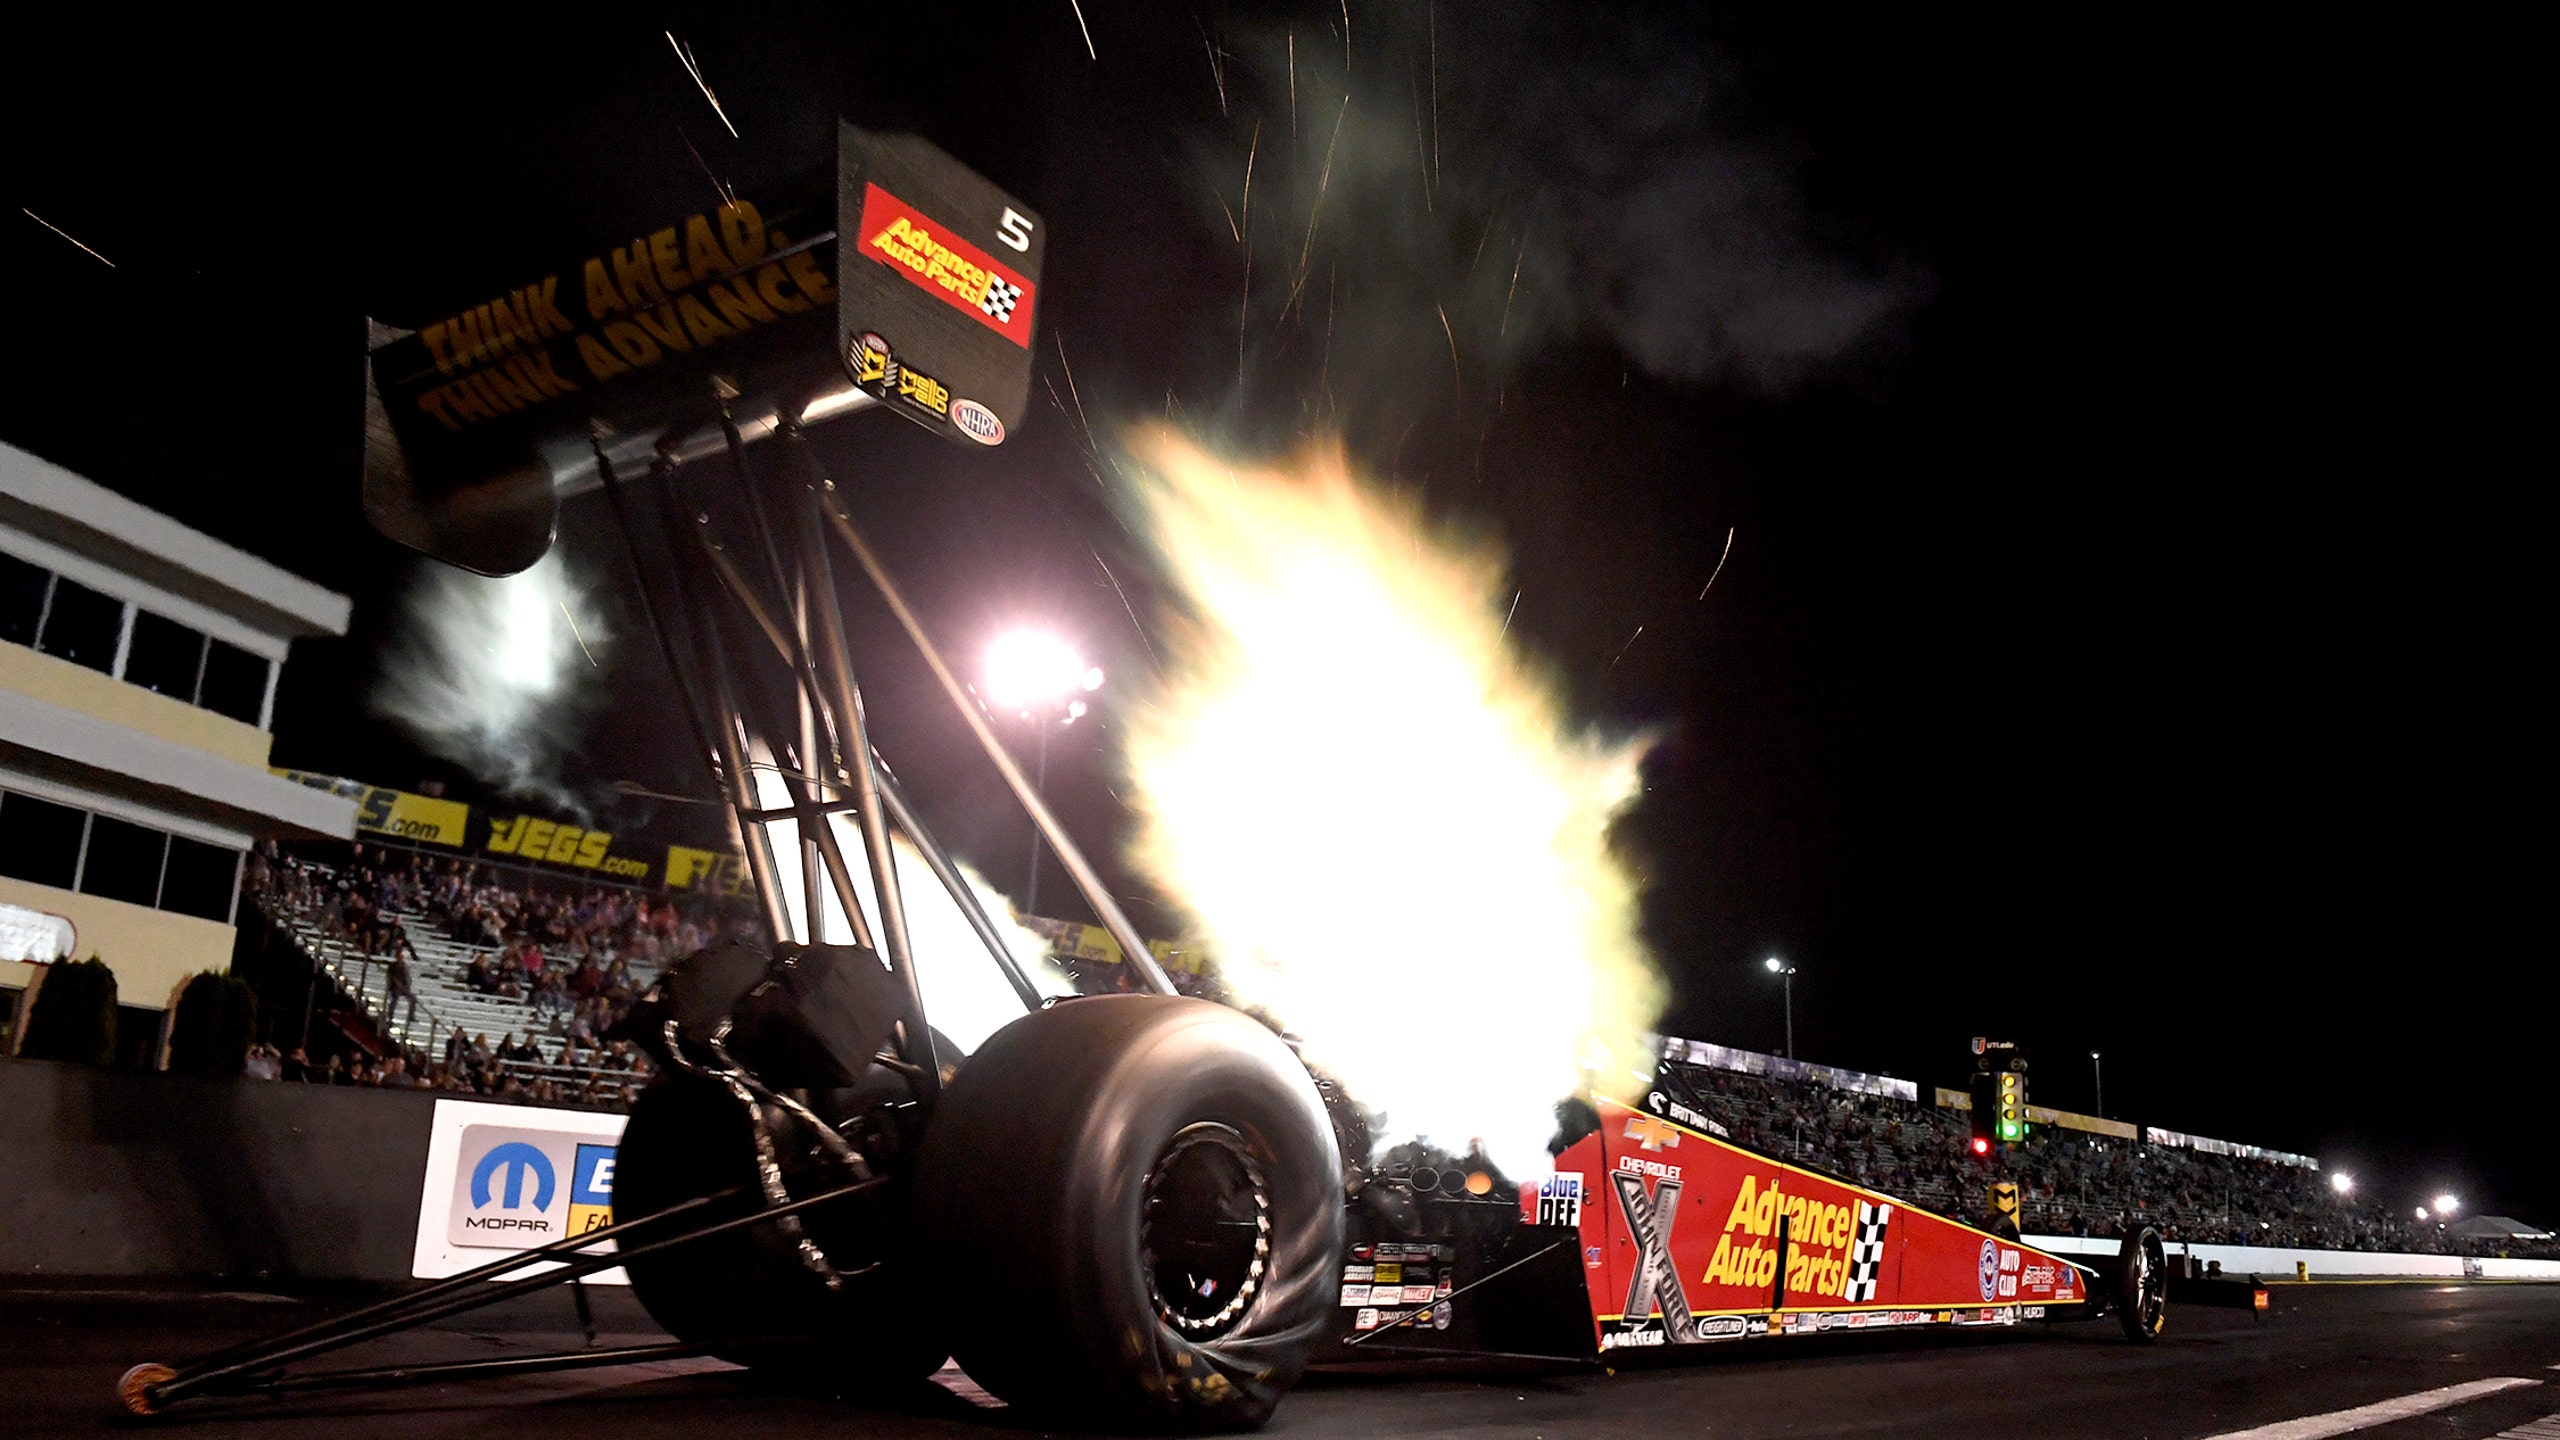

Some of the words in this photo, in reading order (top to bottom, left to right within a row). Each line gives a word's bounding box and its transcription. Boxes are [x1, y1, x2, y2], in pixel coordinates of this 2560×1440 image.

[885, 216, 986, 287] Advance
[996, 206, 1034, 253] 5
[870, 230, 927, 273] Auto
[924, 258, 980, 305] Parts
[417, 347, 581, 431] THINK
[574, 248, 836, 383] ADVANCE
[420, 273, 575, 377] THINK
[959, 408, 998, 438] NHRA
[487, 815, 650, 878] JEGS.com
[1540, 1174, 1579, 1199] Blue
[1620, 1156, 1683, 1180] CHEVROLET
[466, 1217, 549, 1232] MOPAR
[1540, 1198, 1578, 1226] DEF
[1724, 1175, 1851, 1249] Advance
[1702, 1234, 1777, 1288] Auto
[1784, 1241, 1843, 1296] Parts
[2000, 1249, 2020, 1272] AUTO
[1998, 1275, 2017, 1297] CLUB
